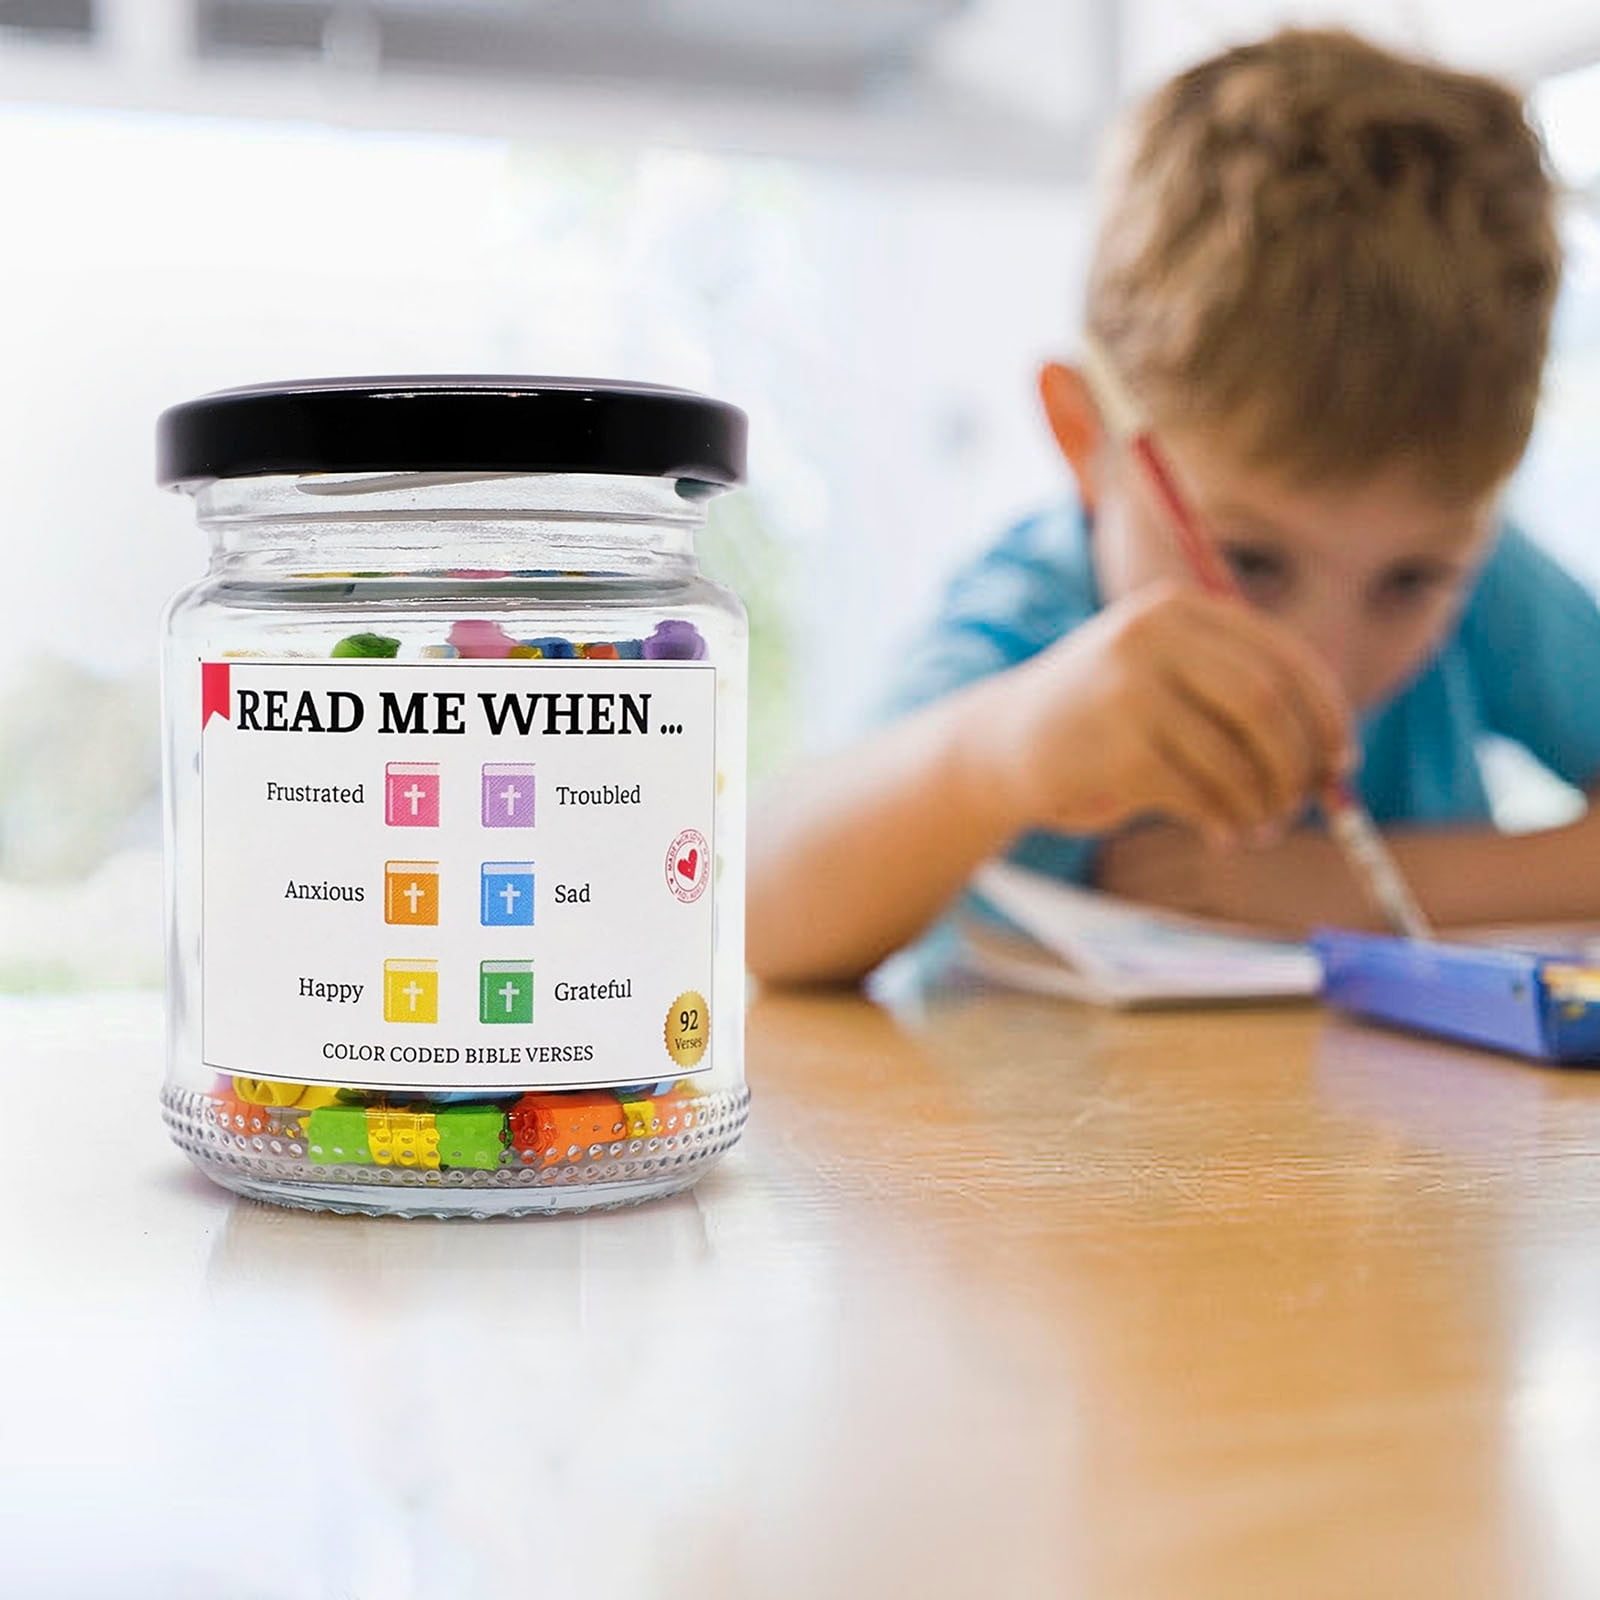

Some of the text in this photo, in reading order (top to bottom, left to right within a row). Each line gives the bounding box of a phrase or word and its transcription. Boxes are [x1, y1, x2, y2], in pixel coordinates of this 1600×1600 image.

[236, 689, 365, 733] READ
[377, 691, 466, 735] ME
[477, 692, 652, 736] WHEN
[266, 782, 365, 804] Frustrated
[555, 784, 641, 806] Troubled
[284, 880, 365, 902] Anxious
[554, 883, 591, 904] Sad
[298, 977, 364, 1004] Happy
[554, 978, 632, 1002] Grateful
[680, 1009, 699, 1032] 92
[322, 1042, 594, 1064] COLOR CODED BIBLE VERSES
[674, 1037, 703, 1050] Verses
